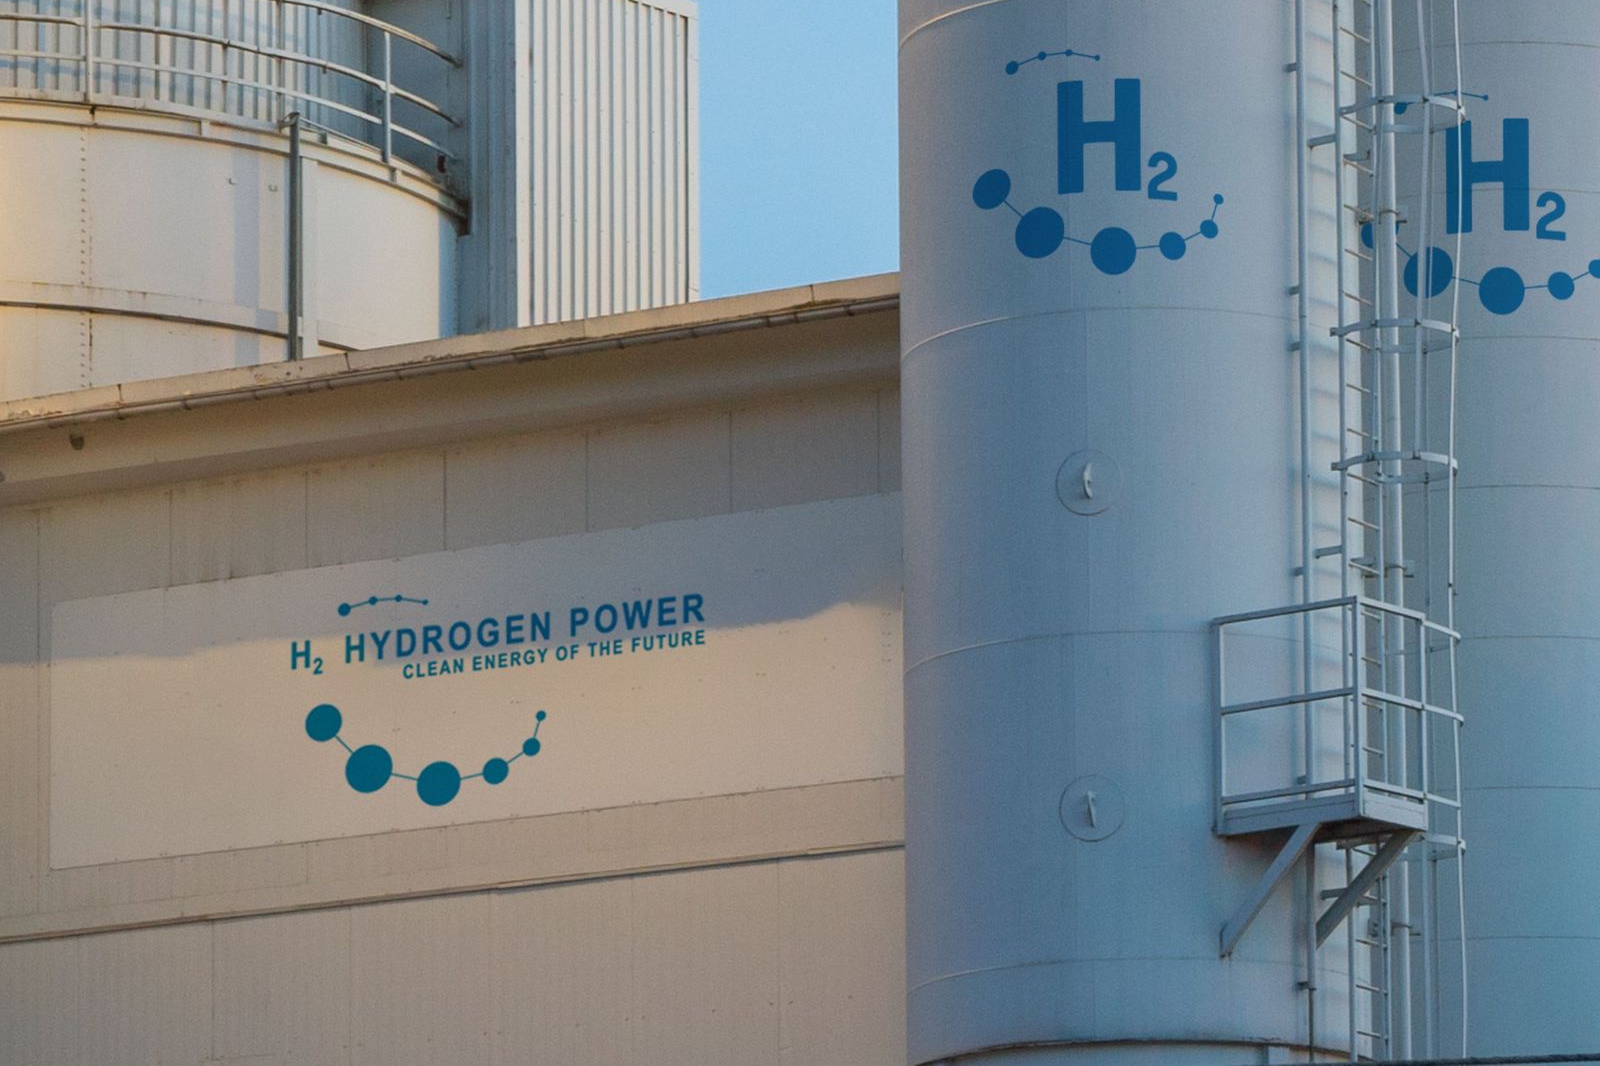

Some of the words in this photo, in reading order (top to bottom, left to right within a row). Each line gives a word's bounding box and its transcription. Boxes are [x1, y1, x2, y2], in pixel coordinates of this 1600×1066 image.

[1056, 78, 1178, 201] H2
[1445, 118, 1567, 242] H2
[290, 639, 324, 676] H2
[344, 612, 551, 665] HYDROGEN
[569, 593, 705, 638] POWER
[401, 658, 464, 680] CLEAN
[472, 647, 548, 672] ENERGY
[555, 643, 580, 662] OF
[587, 637, 624, 658] THE
[631, 629, 706, 653] FUTURE
